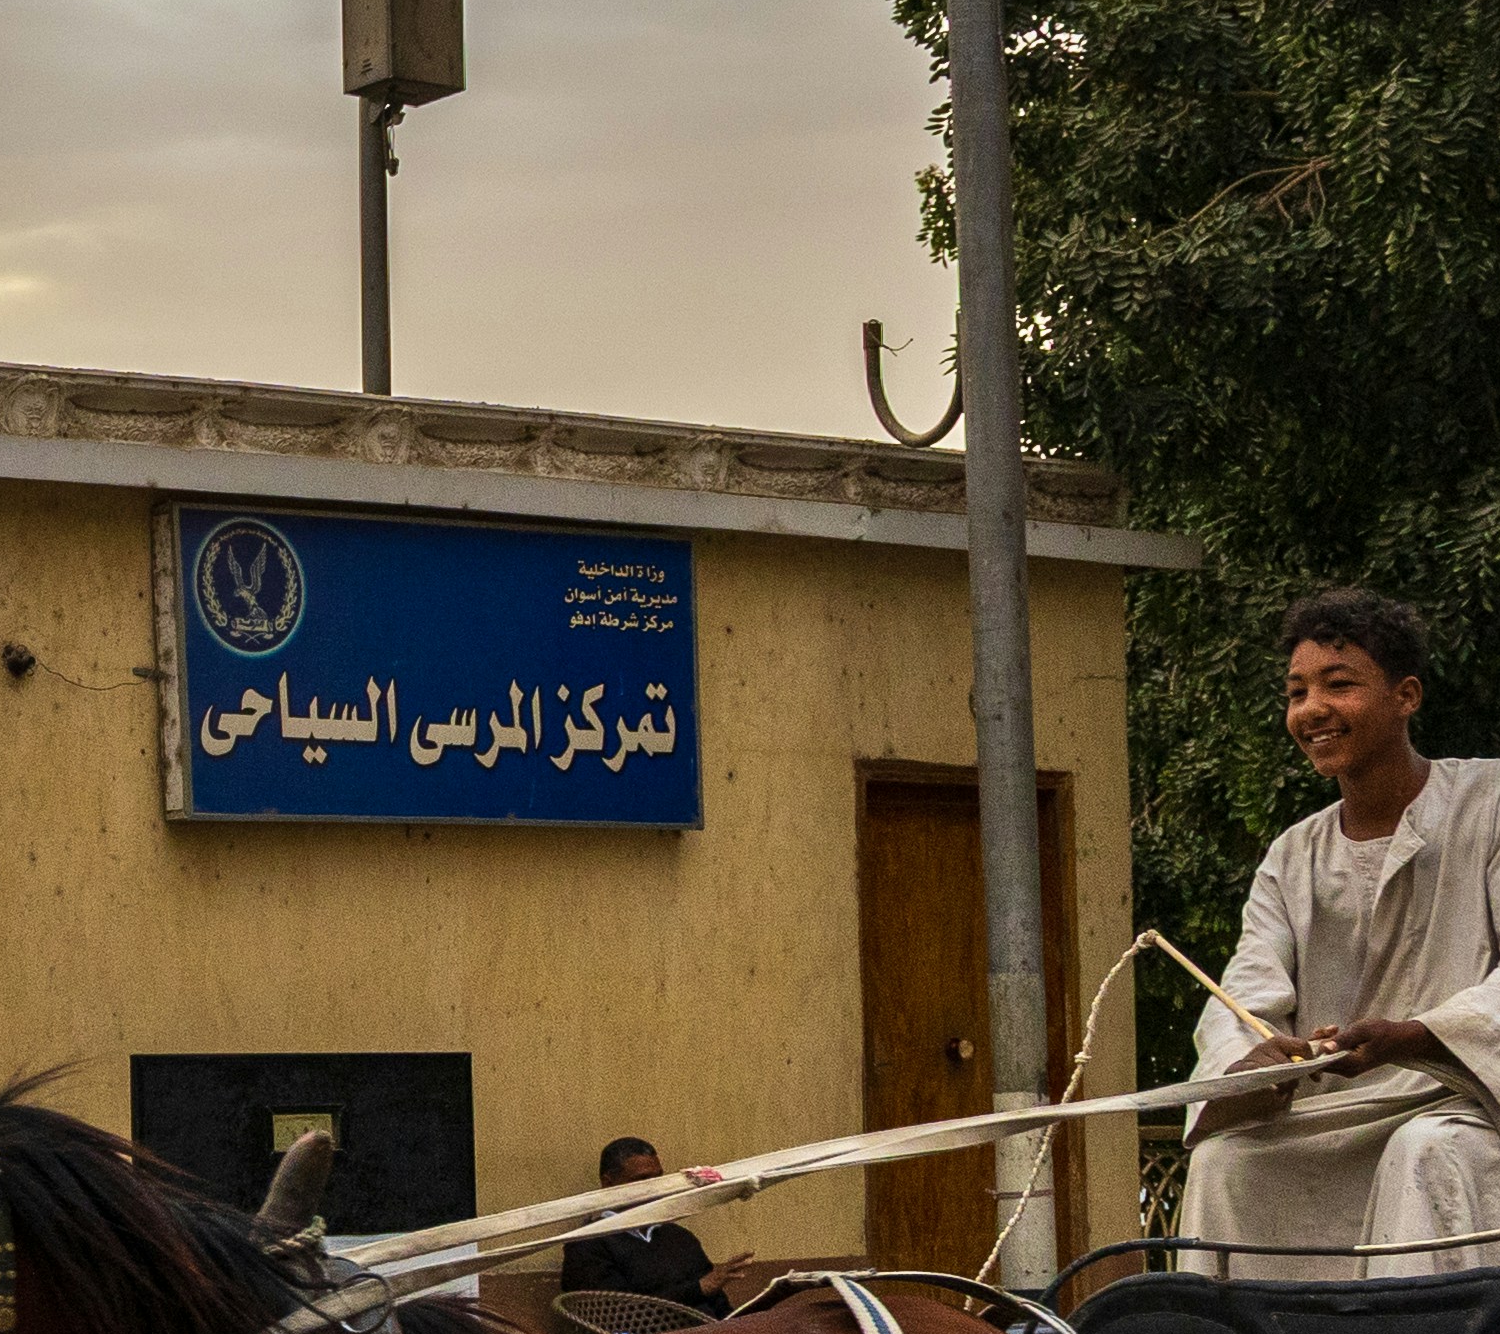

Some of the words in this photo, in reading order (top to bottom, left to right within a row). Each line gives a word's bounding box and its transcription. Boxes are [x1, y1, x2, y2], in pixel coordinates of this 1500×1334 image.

[577, 560, 634, 580] الداخلية
[564, 585, 602, 604] أسوان
[629, 588, 678, 608] مديرية
[599, 611, 639, 631] شرطة
[641, 615, 674, 632] مركز
[550, 683, 676, 772] تمركز
